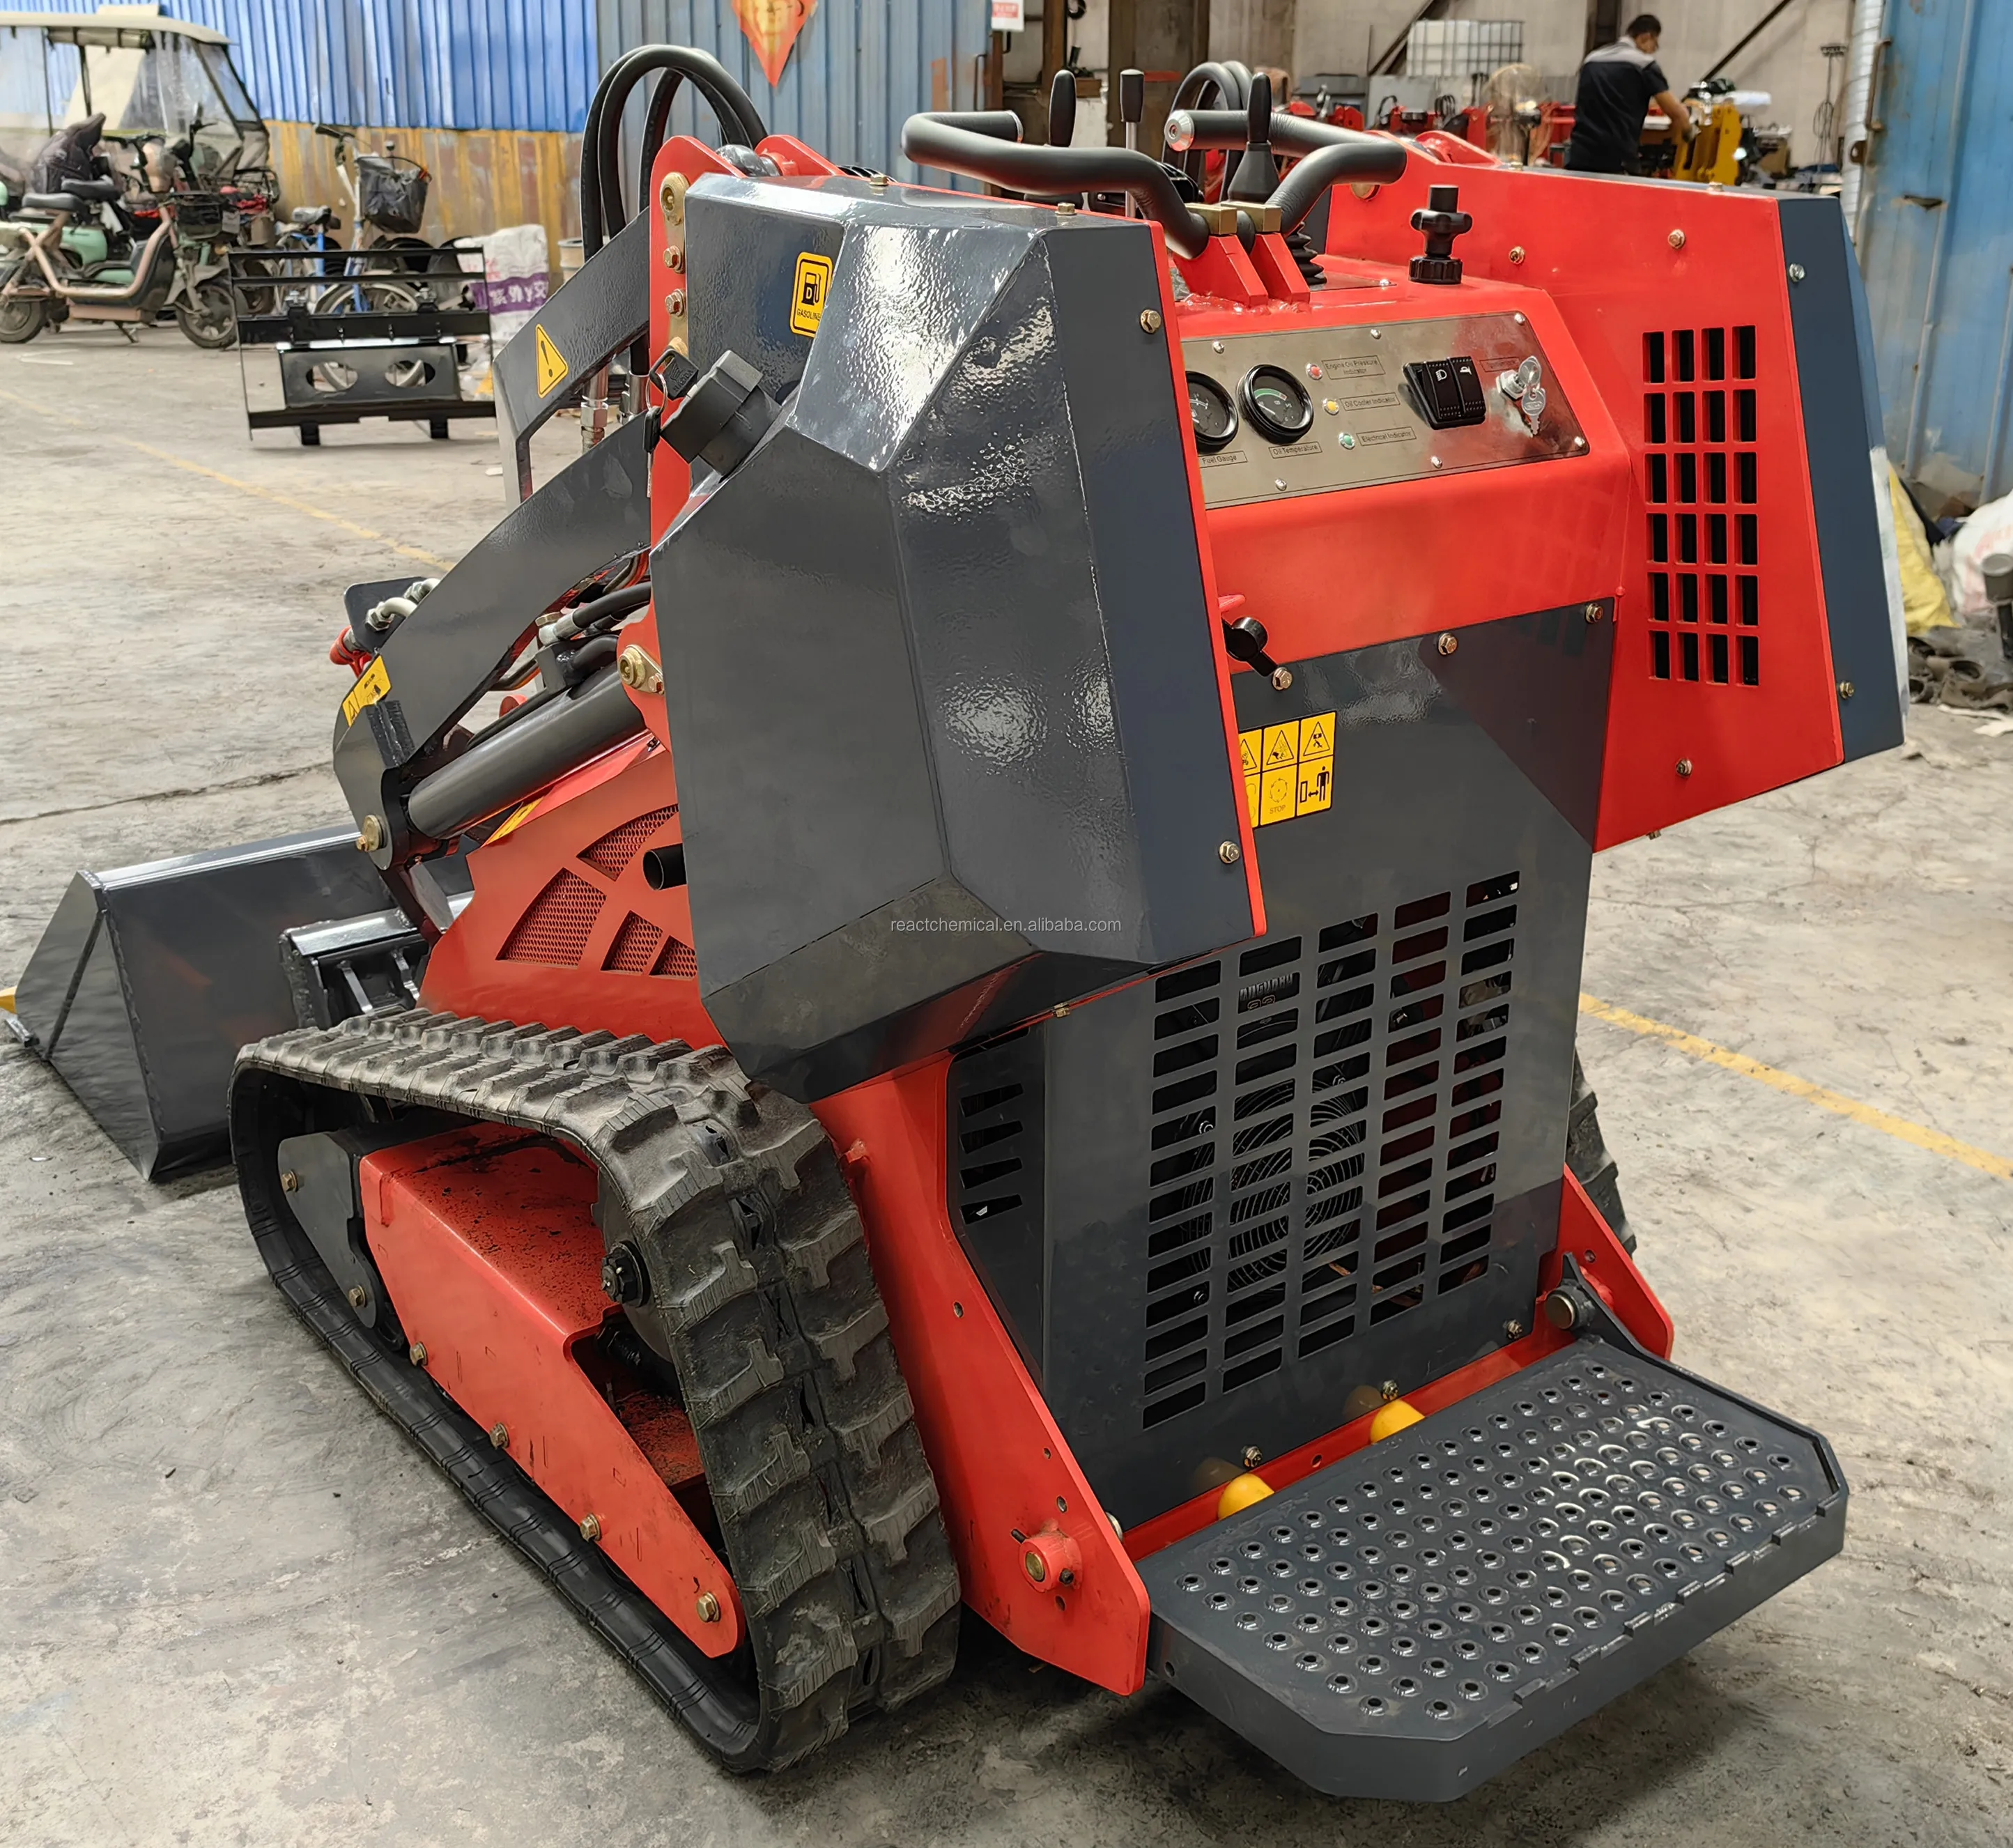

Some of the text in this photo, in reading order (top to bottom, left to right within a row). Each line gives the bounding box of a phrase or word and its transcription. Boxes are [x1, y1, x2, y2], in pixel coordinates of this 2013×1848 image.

[1361, 433, 1387, 442] Electrical
[1282, 445, 1318, 454] Temperature
[1270, 804, 1286, 814] STOP
